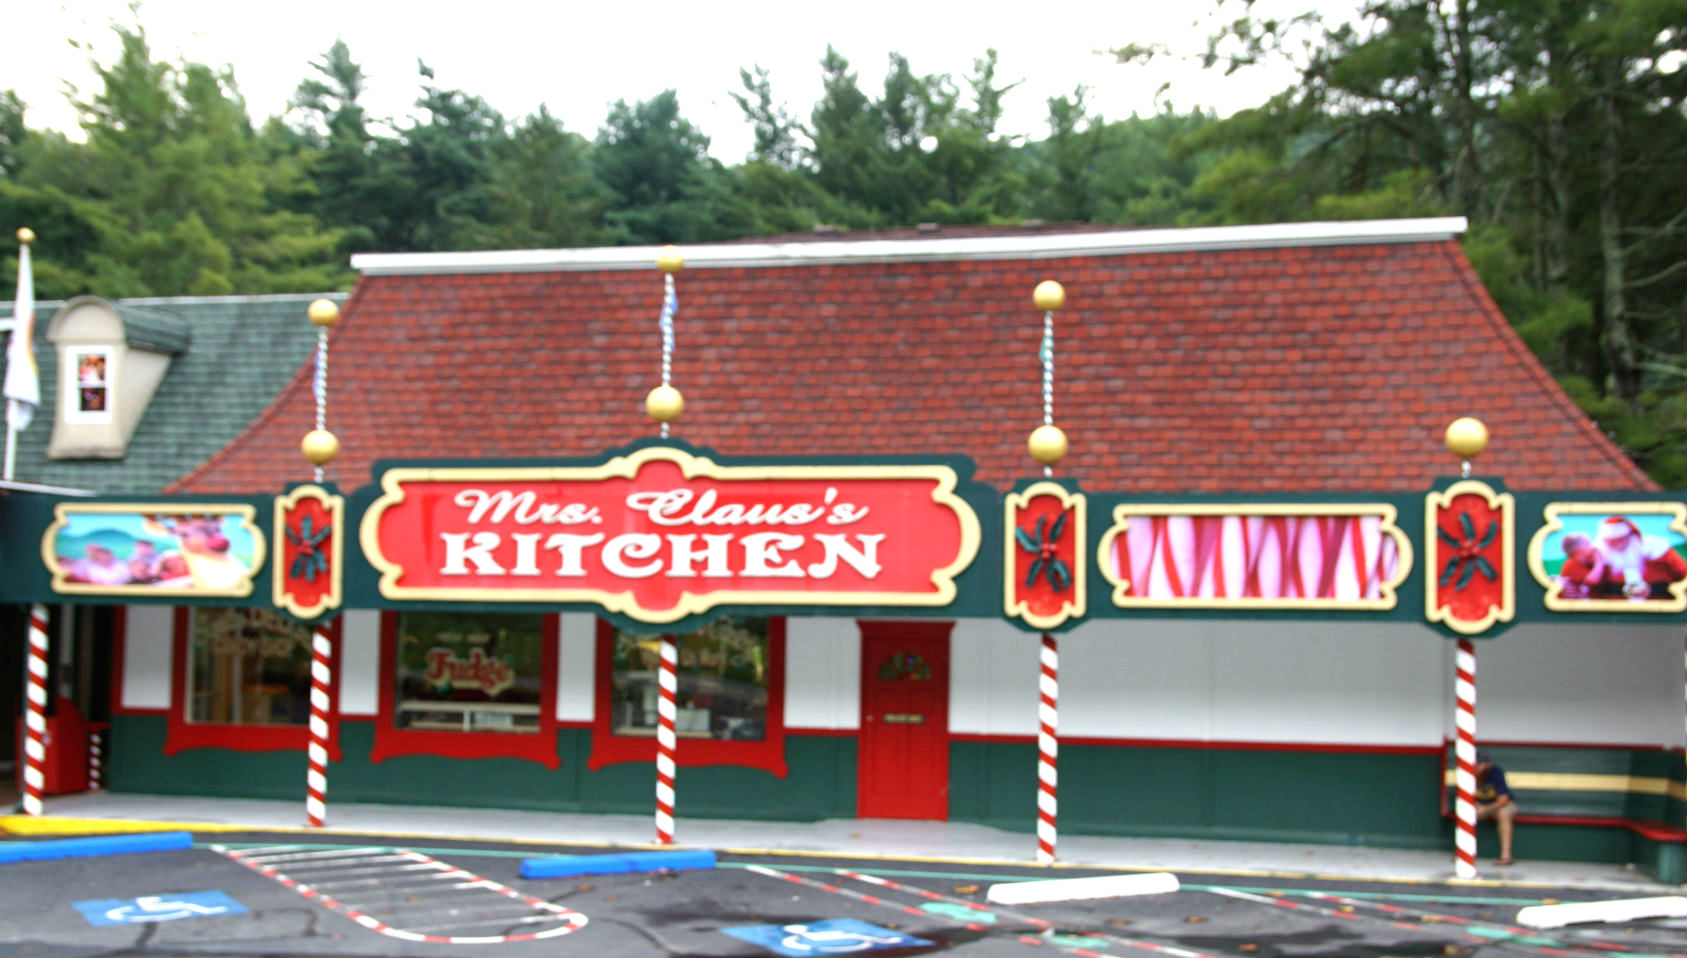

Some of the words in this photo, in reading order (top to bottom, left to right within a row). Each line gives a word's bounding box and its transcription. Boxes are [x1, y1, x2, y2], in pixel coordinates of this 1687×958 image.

[454, 488, 603, 525] Mrs.
[625, 486, 870, 527] Claus's
[438, 531, 887, 579] KITCHEN
[424, 648, 513, 693] Fudge
